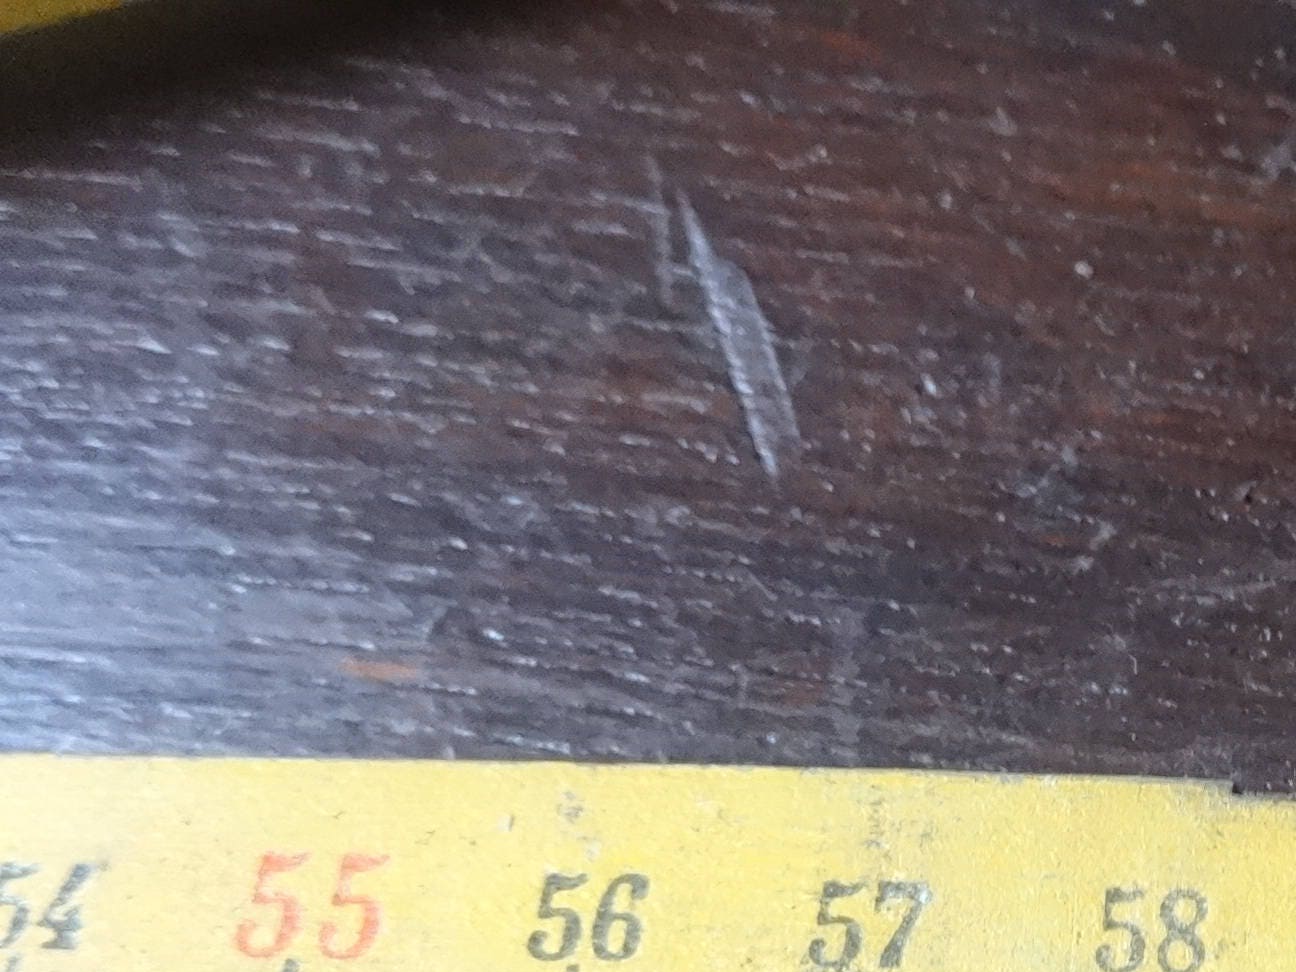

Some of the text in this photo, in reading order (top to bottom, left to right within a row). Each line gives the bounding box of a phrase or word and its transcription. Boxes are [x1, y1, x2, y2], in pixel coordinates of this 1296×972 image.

[234, 852, 390, 960] 55
[526, 872, 650, 962] 56
[808, 880, 932, 969] 57
